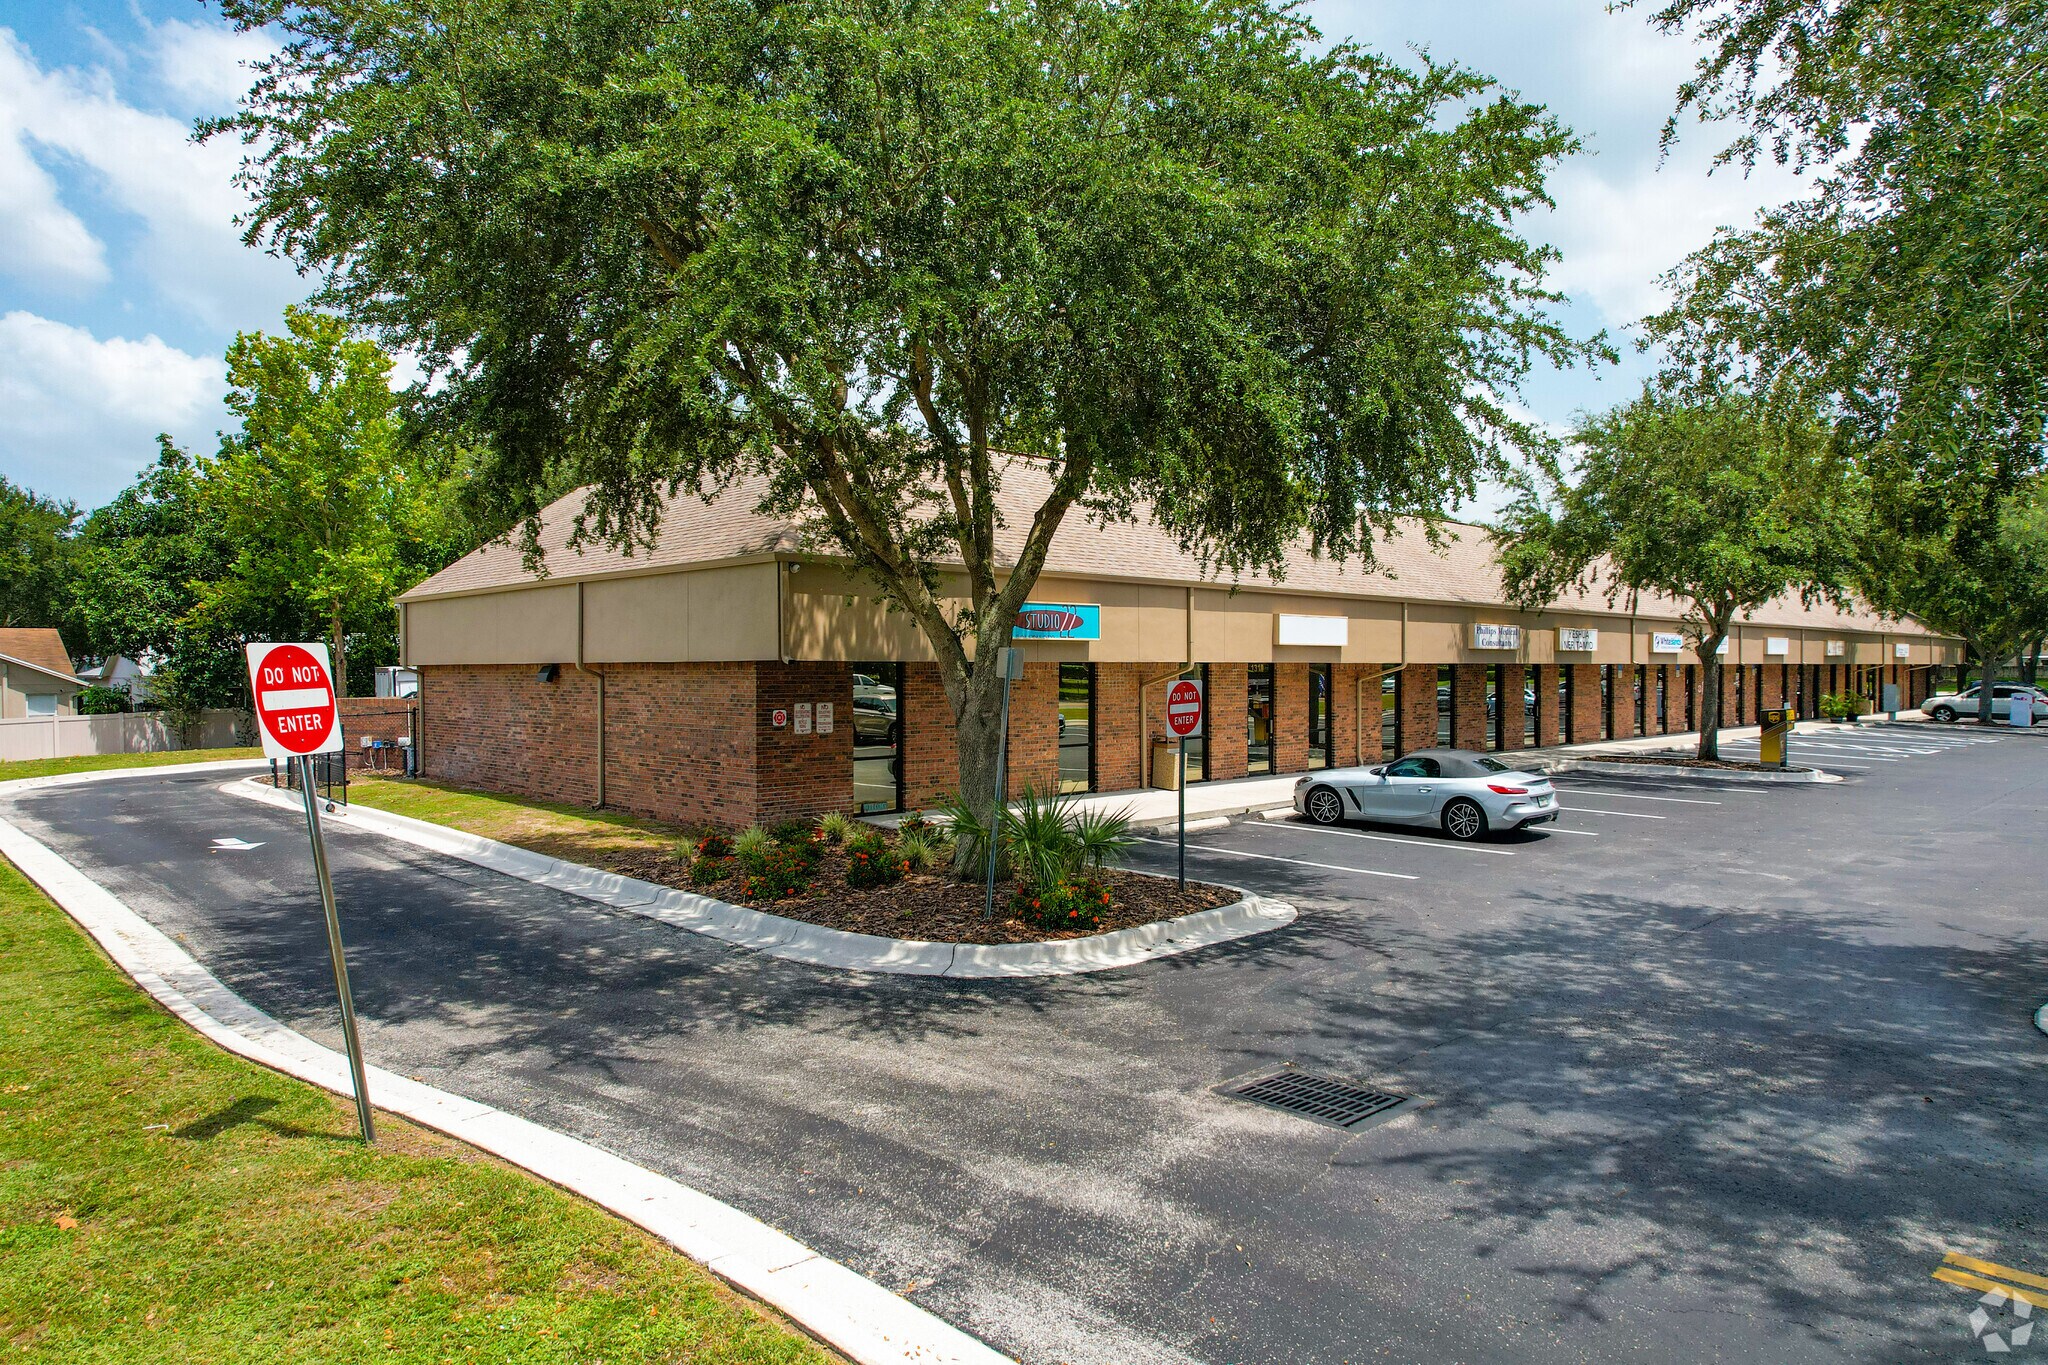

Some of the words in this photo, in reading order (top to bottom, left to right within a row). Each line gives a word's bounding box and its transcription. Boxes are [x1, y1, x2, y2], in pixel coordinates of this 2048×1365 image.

[1025, 613, 1060, 629] STUDIO
[1476, 626, 1497, 637] Phillips
[1498, 626, 1518, 636] Medical
[1481, 638, 1512, 647] Consultants
[264, 667, 284, 685] DO
[292, 666, 319, 683] NOT
[1172, 692, 1181, 702] DO
[1184, 691, 1197, 701] NOT
[278, 714, 323, 734] ENTER
[1174, 715, 1194, 726] ENTER
